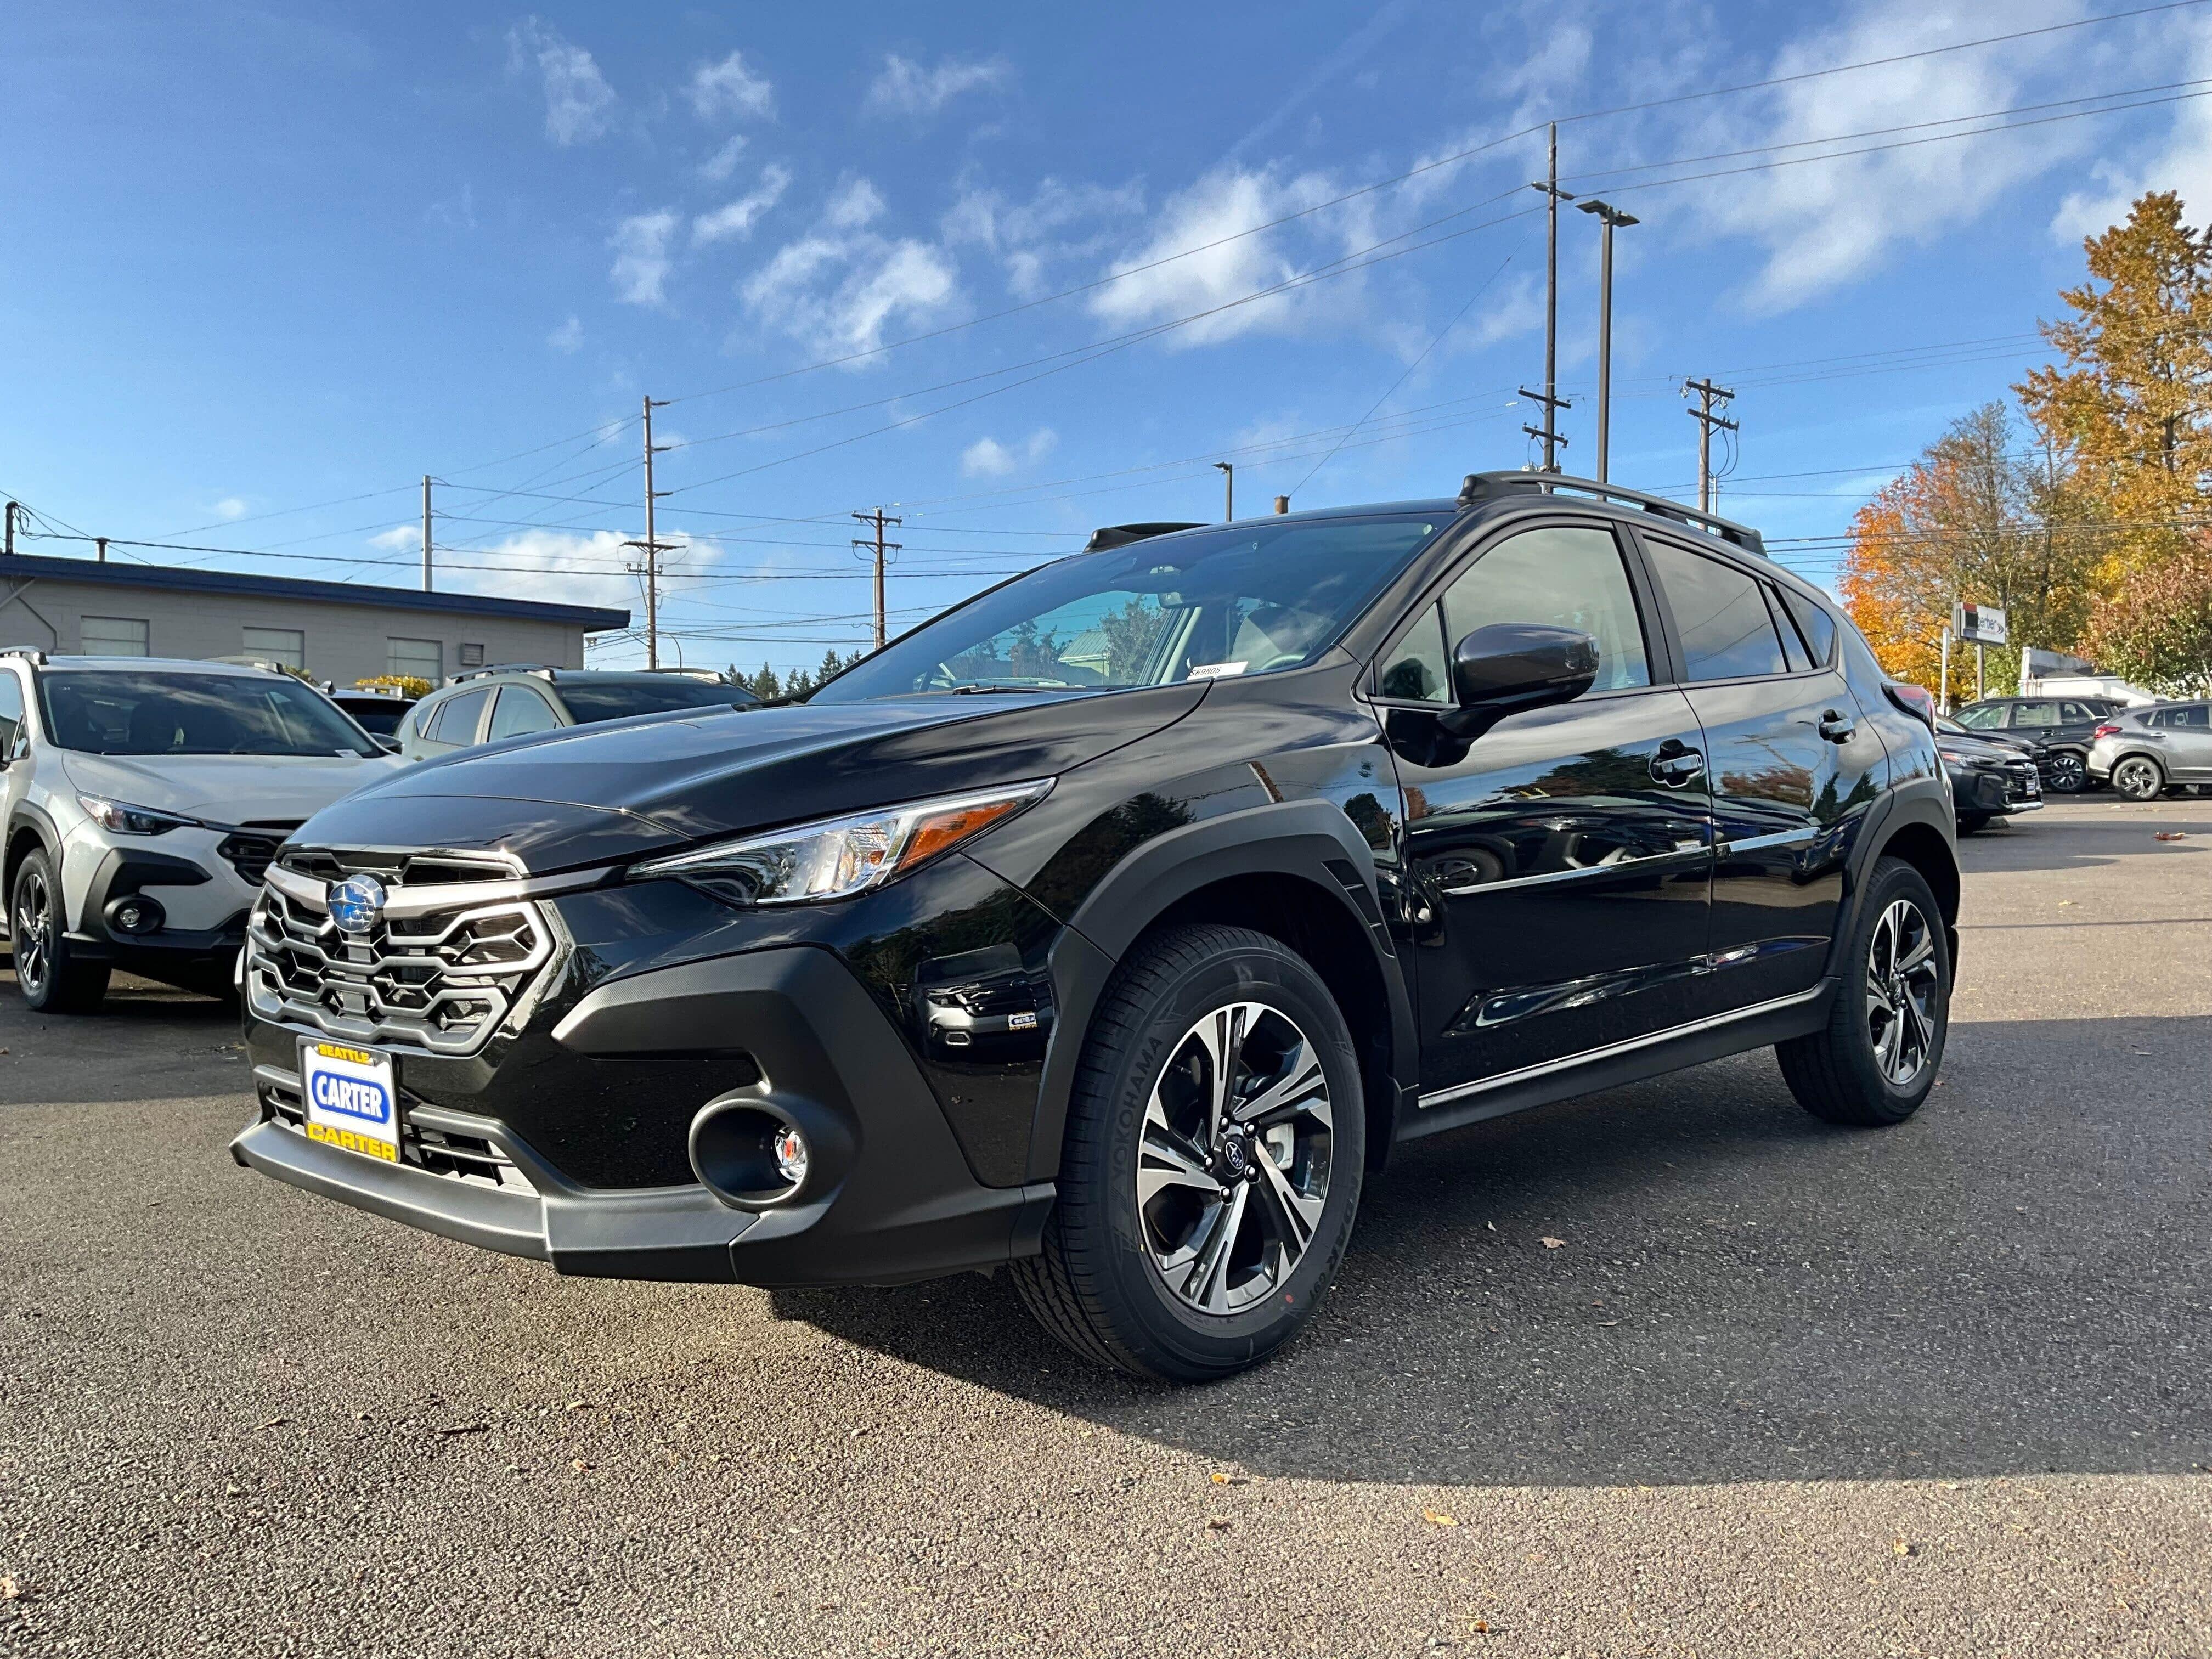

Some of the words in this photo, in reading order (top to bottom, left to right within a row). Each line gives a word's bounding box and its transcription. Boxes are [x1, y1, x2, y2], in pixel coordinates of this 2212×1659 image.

[318, 1043, 369, 1063] SEATTLE
[317, 1075, 383, 1118] CARTER
[1113, 1036, 1163, 1180] YOKOHAMA
[307, 1122, 396, 1162] CARTER
